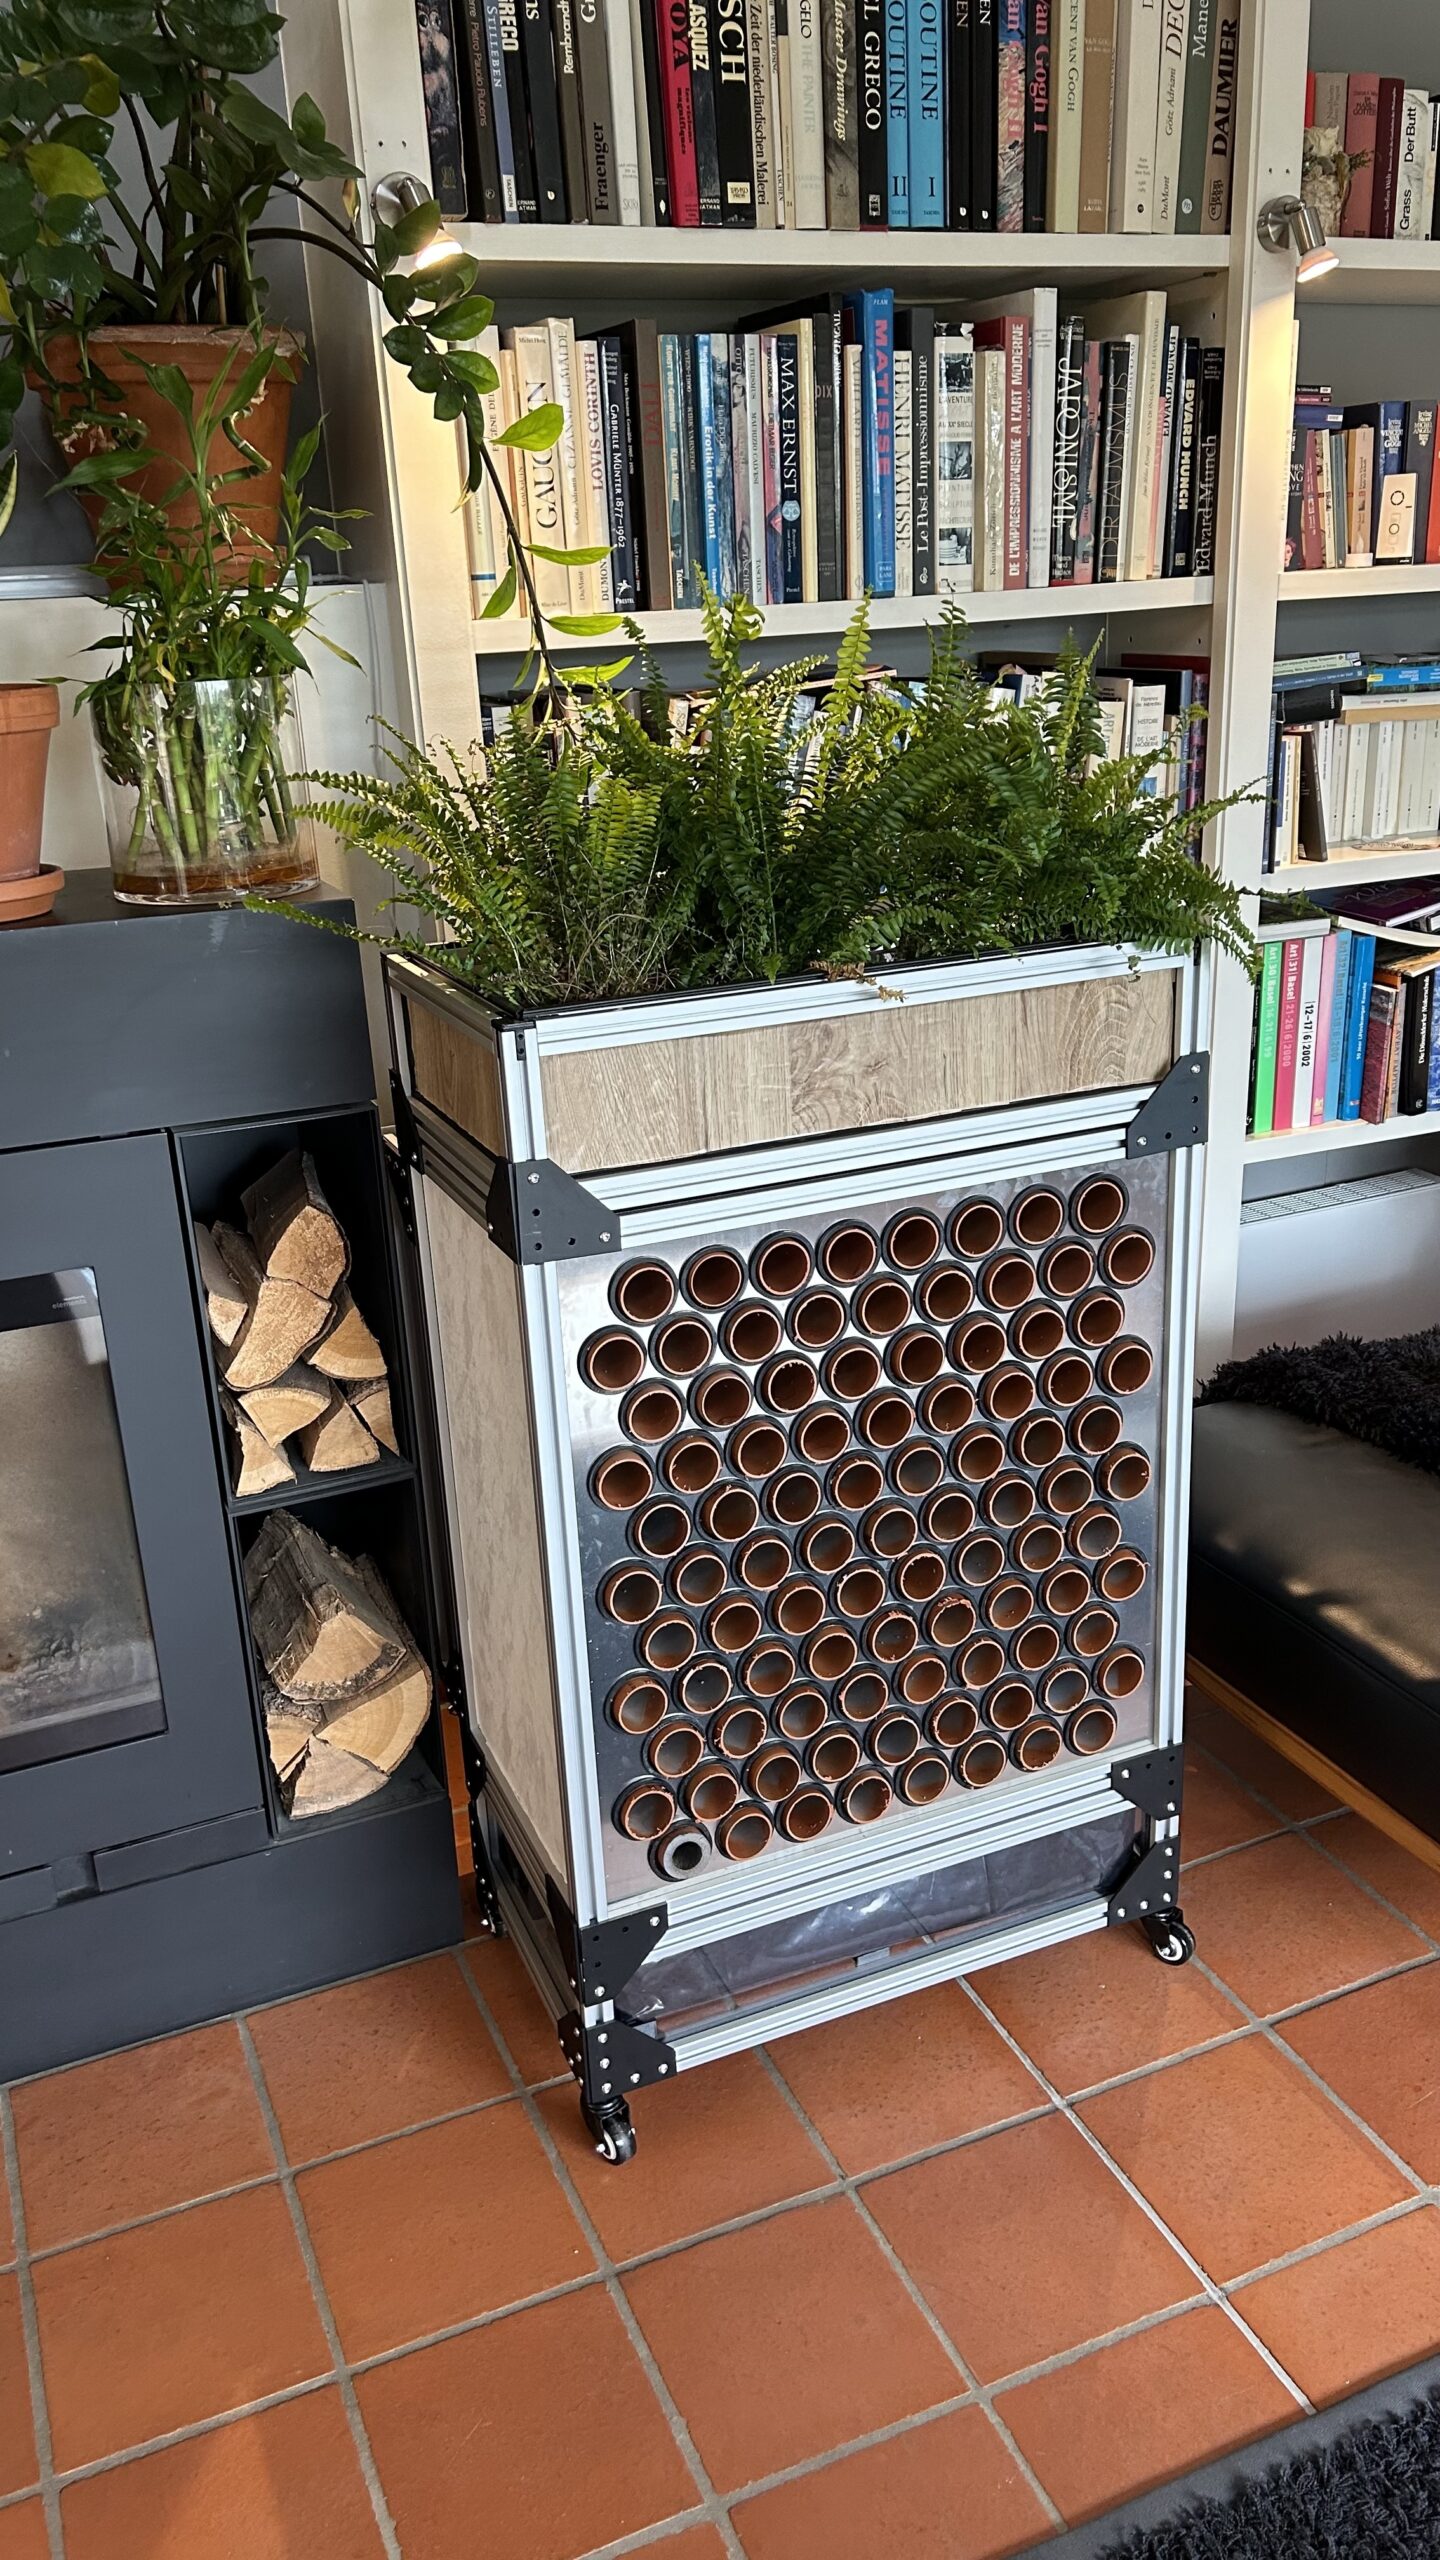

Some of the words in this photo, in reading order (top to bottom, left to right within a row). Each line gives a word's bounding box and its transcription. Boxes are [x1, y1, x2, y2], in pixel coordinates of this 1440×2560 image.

[750, 4, 762, 31] Zeit
[487, 6, 502, 88] STILLEBEN
[751, 32, 761, 55] der
[800, 43, 813, 71] THE
[1068, 36, 1078, 63] VAN
[471, 21, 480, 51] Pietro
[477, 88, 487, 127] Rubens
[864, 31, 882, 130] GRECO
[1029, 44, 1049, 113] Gogh
[1066, 67, 1080, 112] GOGH
[1167, 68, 1177, 106] Adriani
[1212, 18, 1238, 157] DAUMIER
[752, 56, 767, 158] niederländischen
[803, 75, 816, 133] PAINTER
[834, 56, 849, 141] Drawings
[1033, 123, 1049, 133] I
[1165, 108, 1175, 136] Götz
[1406, 107, 1417, 136] Butt
[593, 122, 609, 211] Fraenger
[1405, 137, 1416, 162] Der
[506, 178, 514, 208] TASCHEN
[756, 161, 769, 205] Malerei
[1161, 176, 1170, 220] DuMont
[1400, 189, 1412, 230] Grass
[665, 344, 673, 368] KUNST
[1012, 324, 1024, 385] MODERNE
[1166, 335, 1177, 384] MUNCH
[584, 352, 601, 434] CORINTH
[780, 357, 796, 411] MAX
[816, 384, 832, 398] DIX
[852, 358, 862, 438] VUILLARD
[872, 319, 891, 475] MATISSE
[894, 357, 910, 436] HENRI
[1012, 390, 1023, 421] L'ART
[491, 415, 499, 452] EGÈNE
[609, 403, 620, 450] GABRIELE
[767, 413, 775, 446] DIETMAR
[1013, 426, 1022, 434] A
[1162, 387, 1173, 437] EDVARD
[1181, 378, 1196, 448] EDVARD
[704, 426, 715, 462] Erotik
[768, 448, 776, 470] ELGER
[782, 418, 799, 494] ERNST
[915, 354, 930, 527] Post-Impressionnisme
[1053, 357, 1082, 528] JAPONISME
[1104, 372, 1129, 506] FAUVISMUS
[590, 439, 604, 491] LOVIS
[611, 451, 623, 494] MÜNTER
[706, 465, 715, 475] in
[1178, 451, 1192, 510] MUNCH
[1200, 435, 1217, 502] Munch
[706, 478, 716, 501] der
[895, 449, 911, 551] MATISSE
[1009, 438, 1022, 558] L'IMPRESSIONNISME
[707, 503, 717, 539] Kunst
[917, 529, 929, 553] Le
[1101, 515, 1121, 559] DER
[1195, 503, 1214, 572] Edvard
[676, 568, 684, 598] TASCHEN
[741, 552, 751, 594] TASCHEN
[755, 559, 763, 593] TASCHEN
[1009, 562, 1020, 576] DE
[1103, 713, 1115, 734] ART
[1421, 975, 1430, 1012] Malerschule
